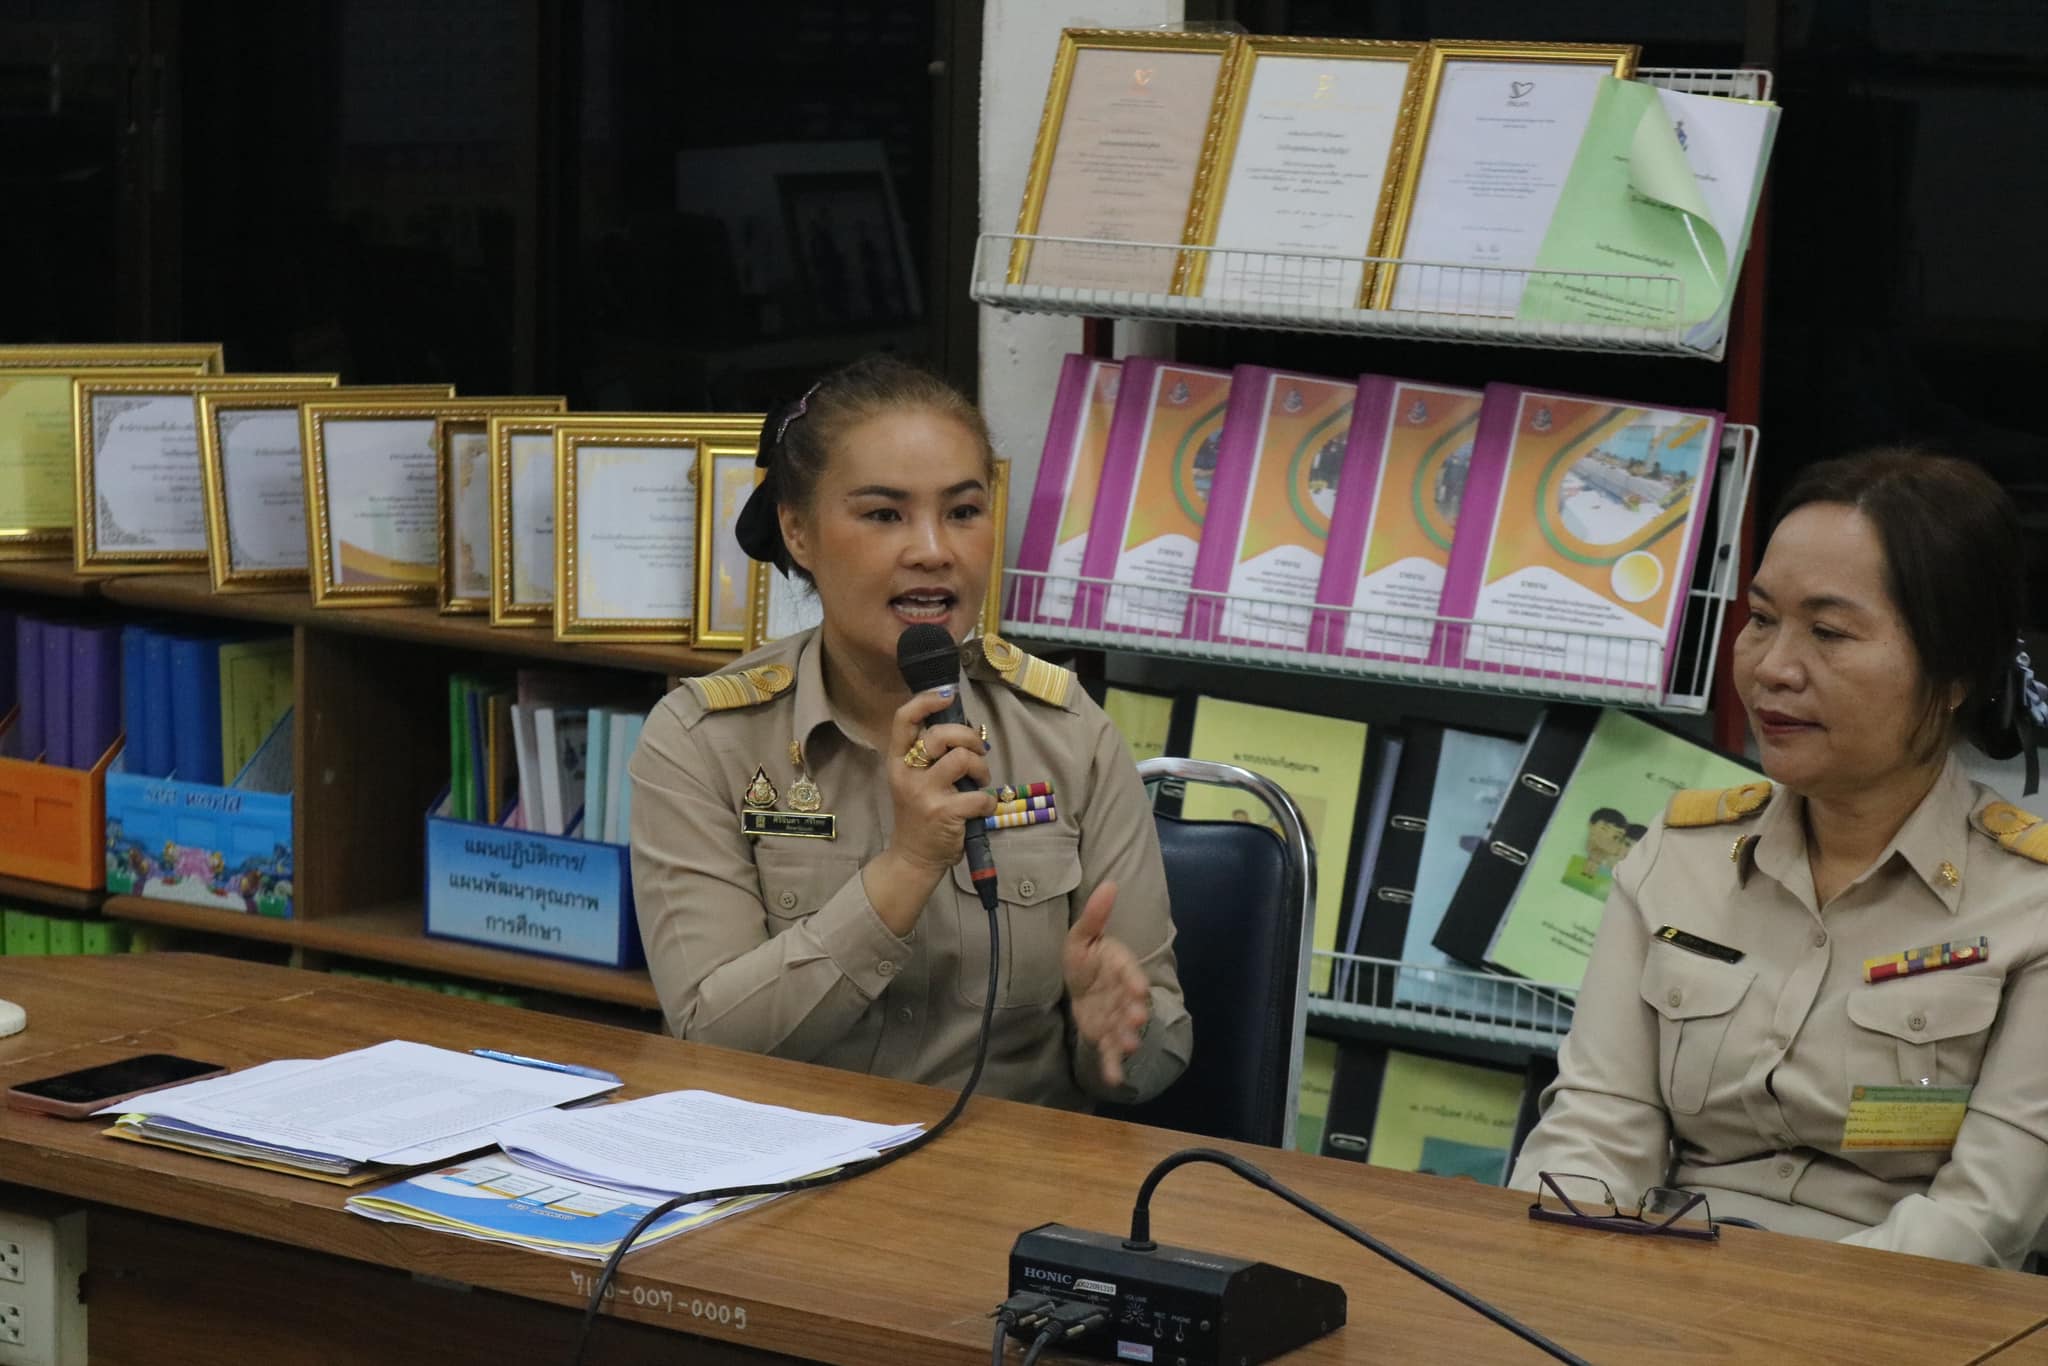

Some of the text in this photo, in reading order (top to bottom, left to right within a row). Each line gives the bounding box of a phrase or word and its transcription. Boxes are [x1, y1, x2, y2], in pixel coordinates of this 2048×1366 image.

[144, 786, 242, 813] sea world
[464, 838, 587, 873] แผนปฏิบัติการ/
[449, 872, 600, 913] แผนพัฒนาคุณภาพ
[485, 913, 562, 943] การศึกษา
[1023, 1266, 1073, 1285] HONIC
